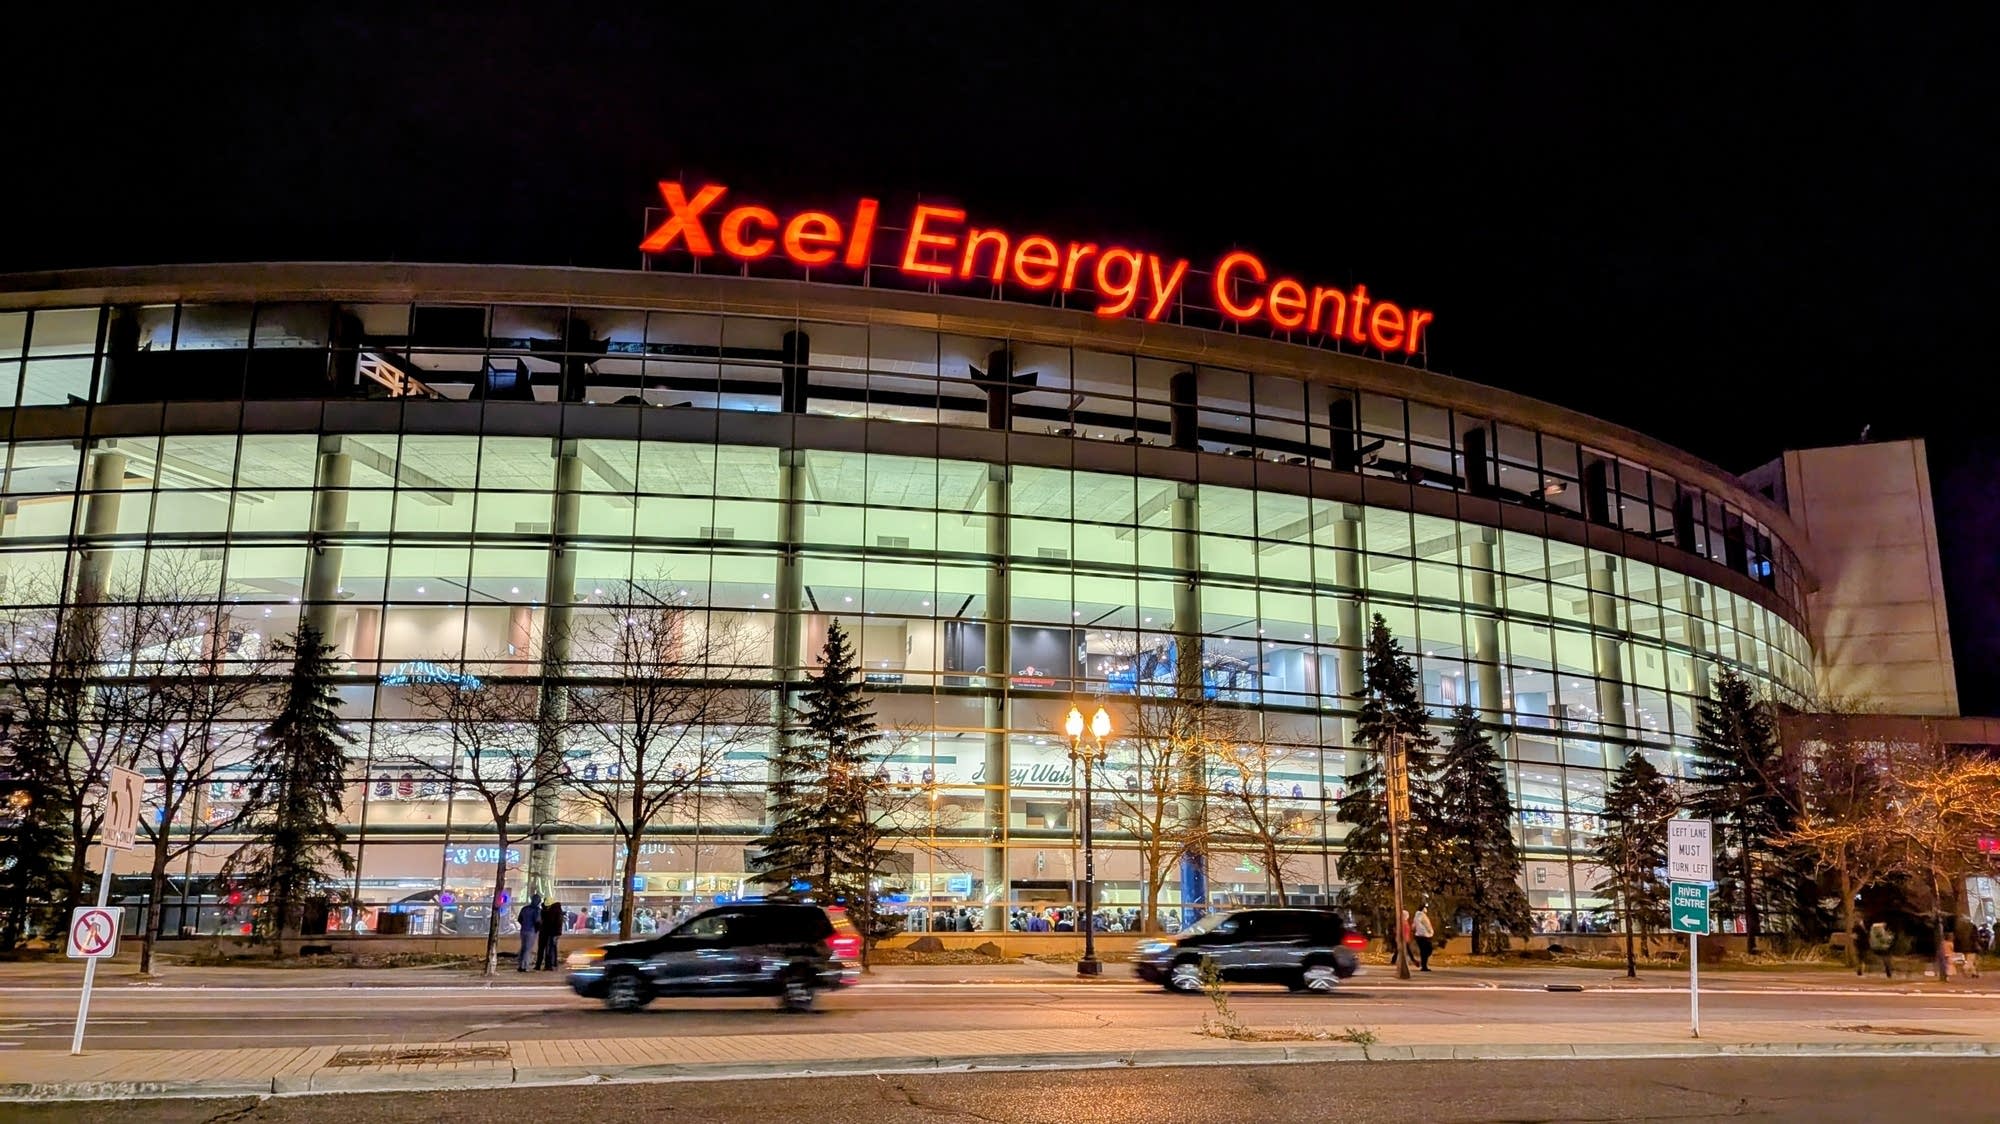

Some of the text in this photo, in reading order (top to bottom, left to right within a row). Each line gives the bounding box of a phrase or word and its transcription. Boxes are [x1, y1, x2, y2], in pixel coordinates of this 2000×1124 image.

[638, 181, 1434, 354] Xcel Energy Center
[971, 762, 1029, 788] Jey
[1672, 827, 1707, 839] LEFT LANE
[1679, 845, 1701, 857] MUST
[1672, 861, 1708, 874] TURN LEFT
[1678, 886, 1701, 898] RIVER
[1674, 897, 1706, 909] CENTRE
